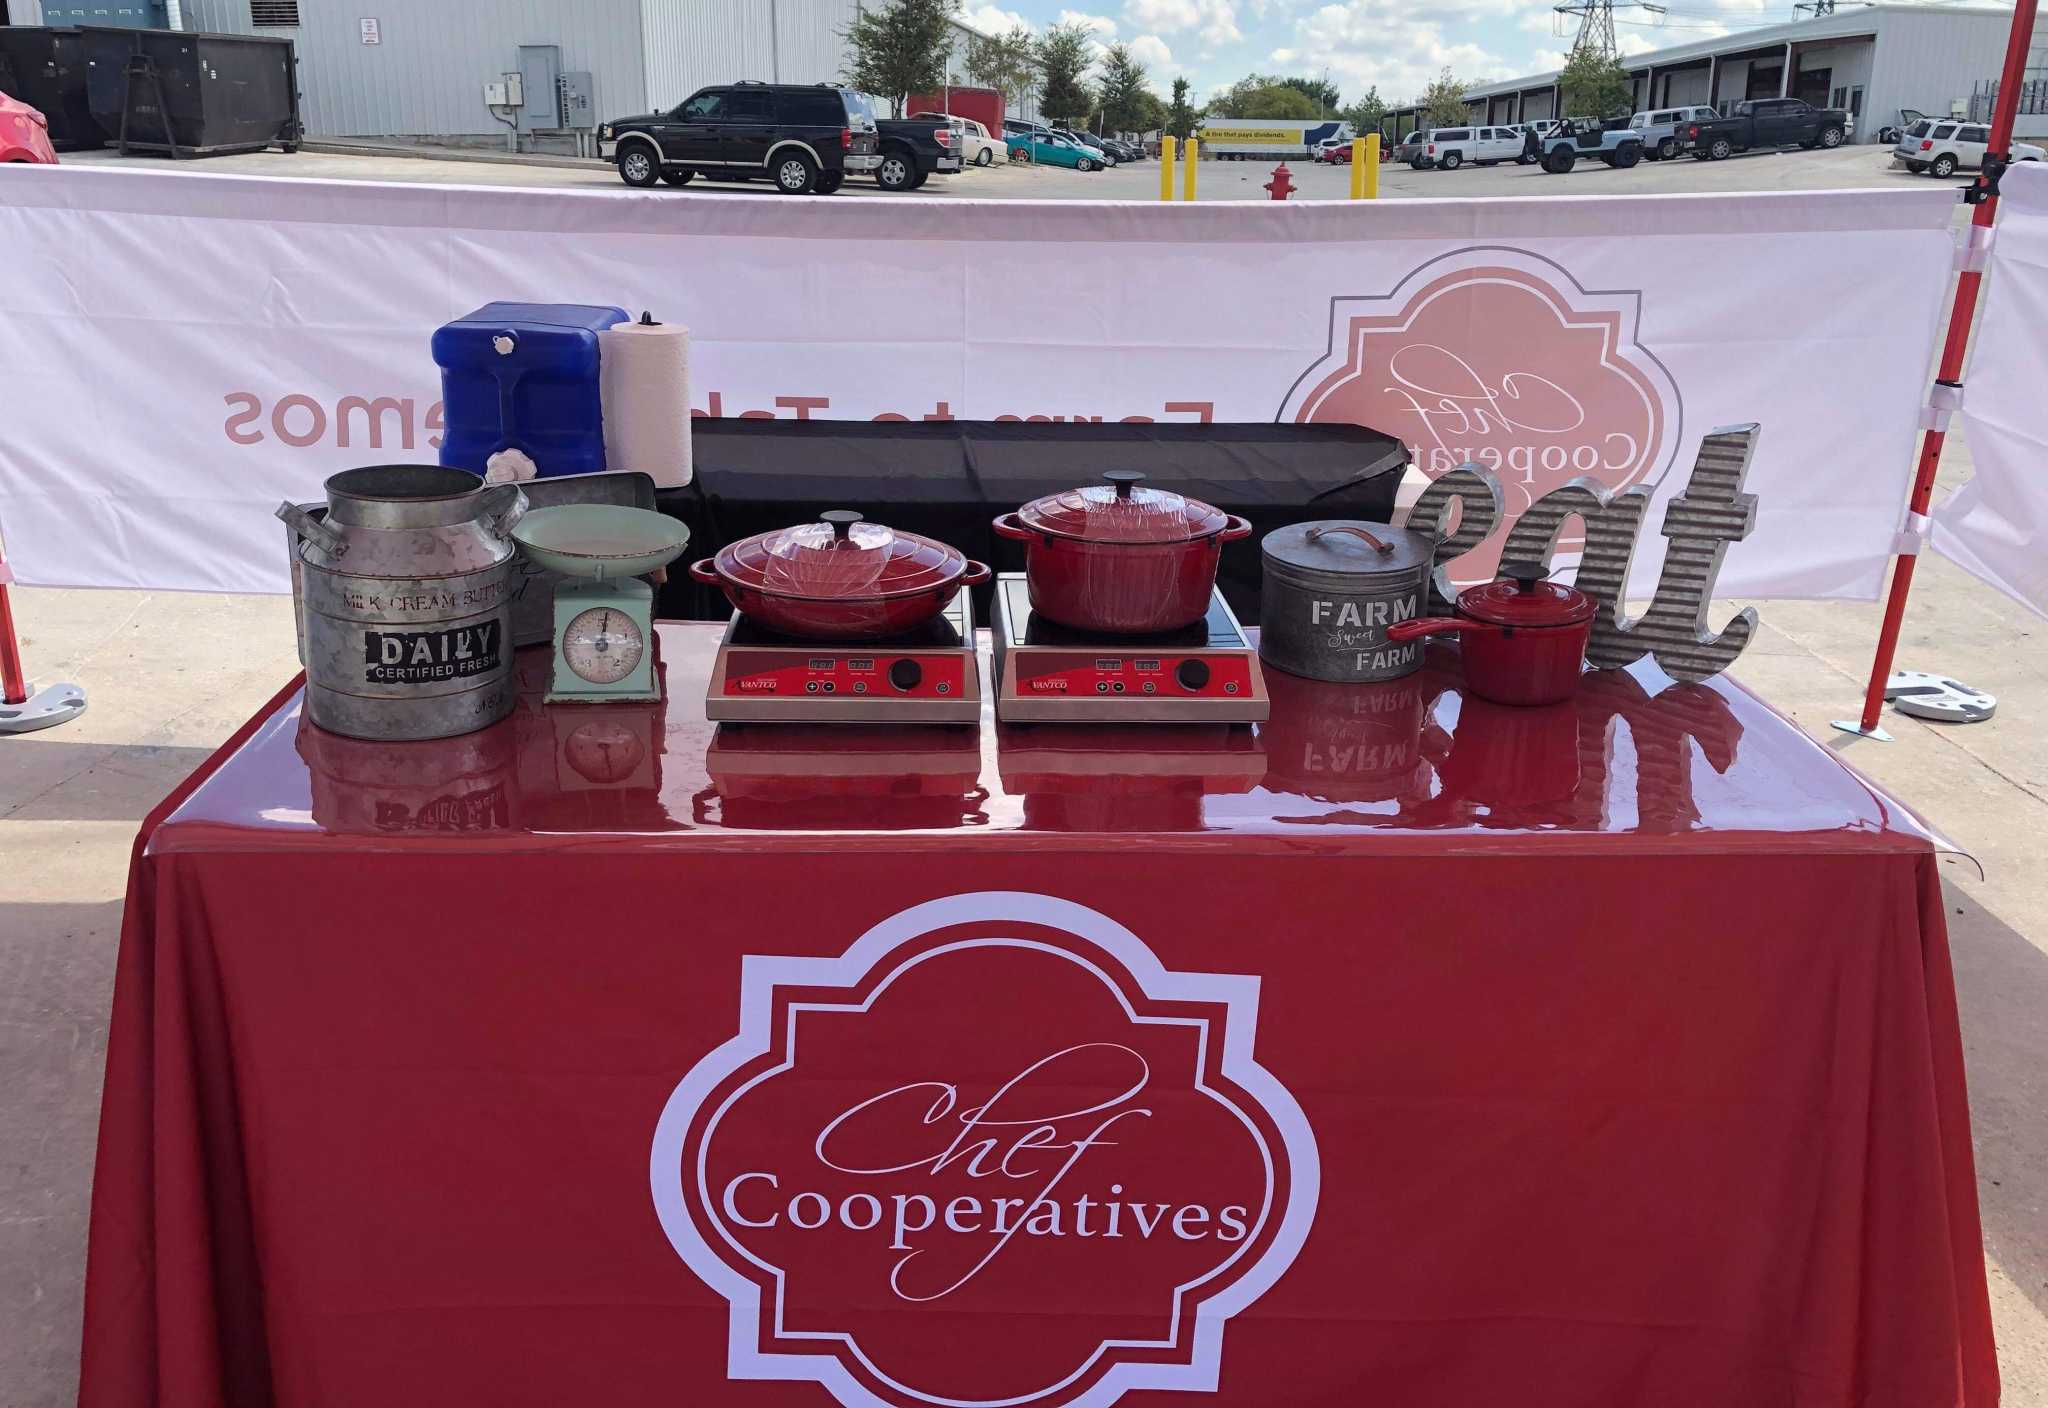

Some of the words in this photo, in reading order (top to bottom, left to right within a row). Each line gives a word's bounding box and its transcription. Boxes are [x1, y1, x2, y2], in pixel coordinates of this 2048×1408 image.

[390, 592, 456, 611] CREAM
[1312, 594, 1417, 627] FARM
[381, 625, 493, 665] DAILY
[1356, 643, 1416, 671] FARM
[375, 664, 454, 679] CERTIFIED
[459, 654, 497, 673] FRESH
[815, 1042, 1152, 1302] Chef
[722, 1172, 1249, 1249] Cooperatives
